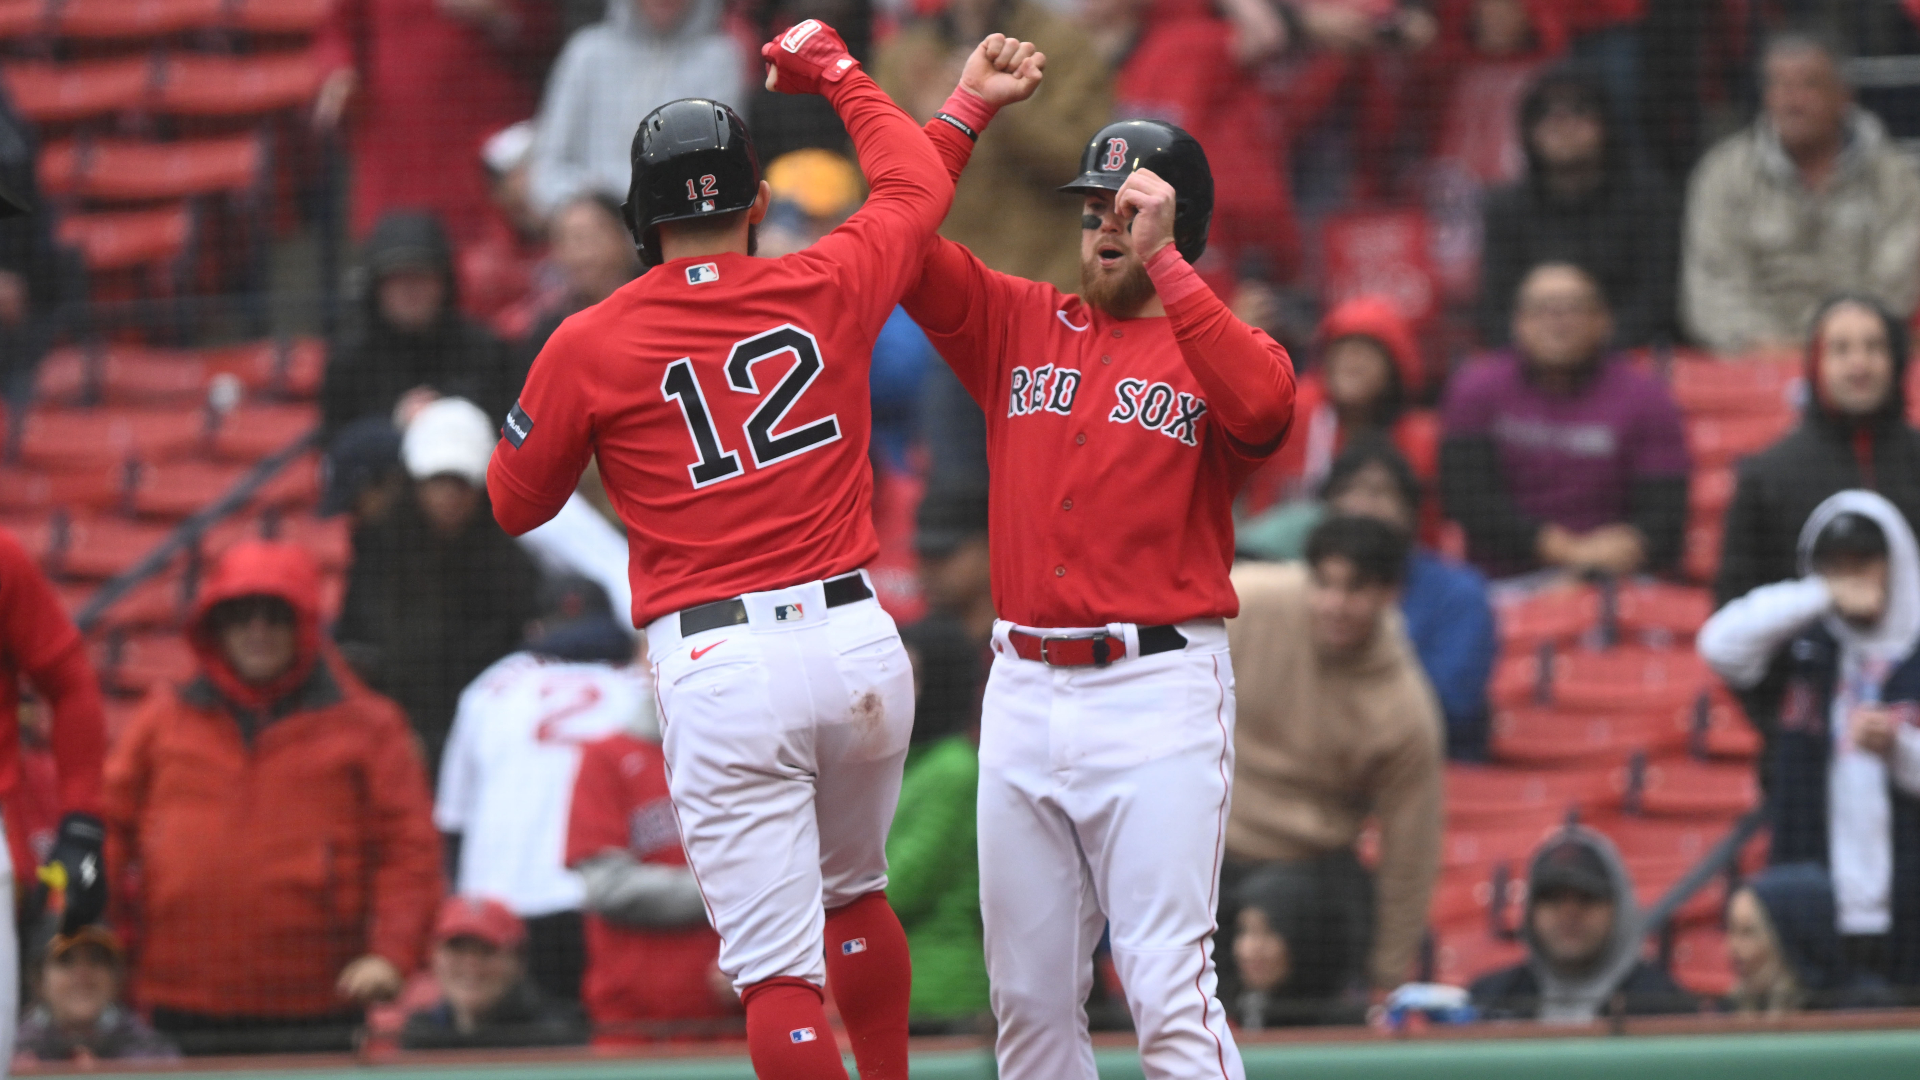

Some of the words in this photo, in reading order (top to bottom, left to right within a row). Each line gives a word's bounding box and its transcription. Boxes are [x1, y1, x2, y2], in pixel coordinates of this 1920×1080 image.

[1102, 138, 1129, 171] B
[686, 174, 719, 200] 12
[660, 323, 843, 490] 12
[1007, 362, 1082, 419] RED
[1108, 377, 1207, 447] SOX
